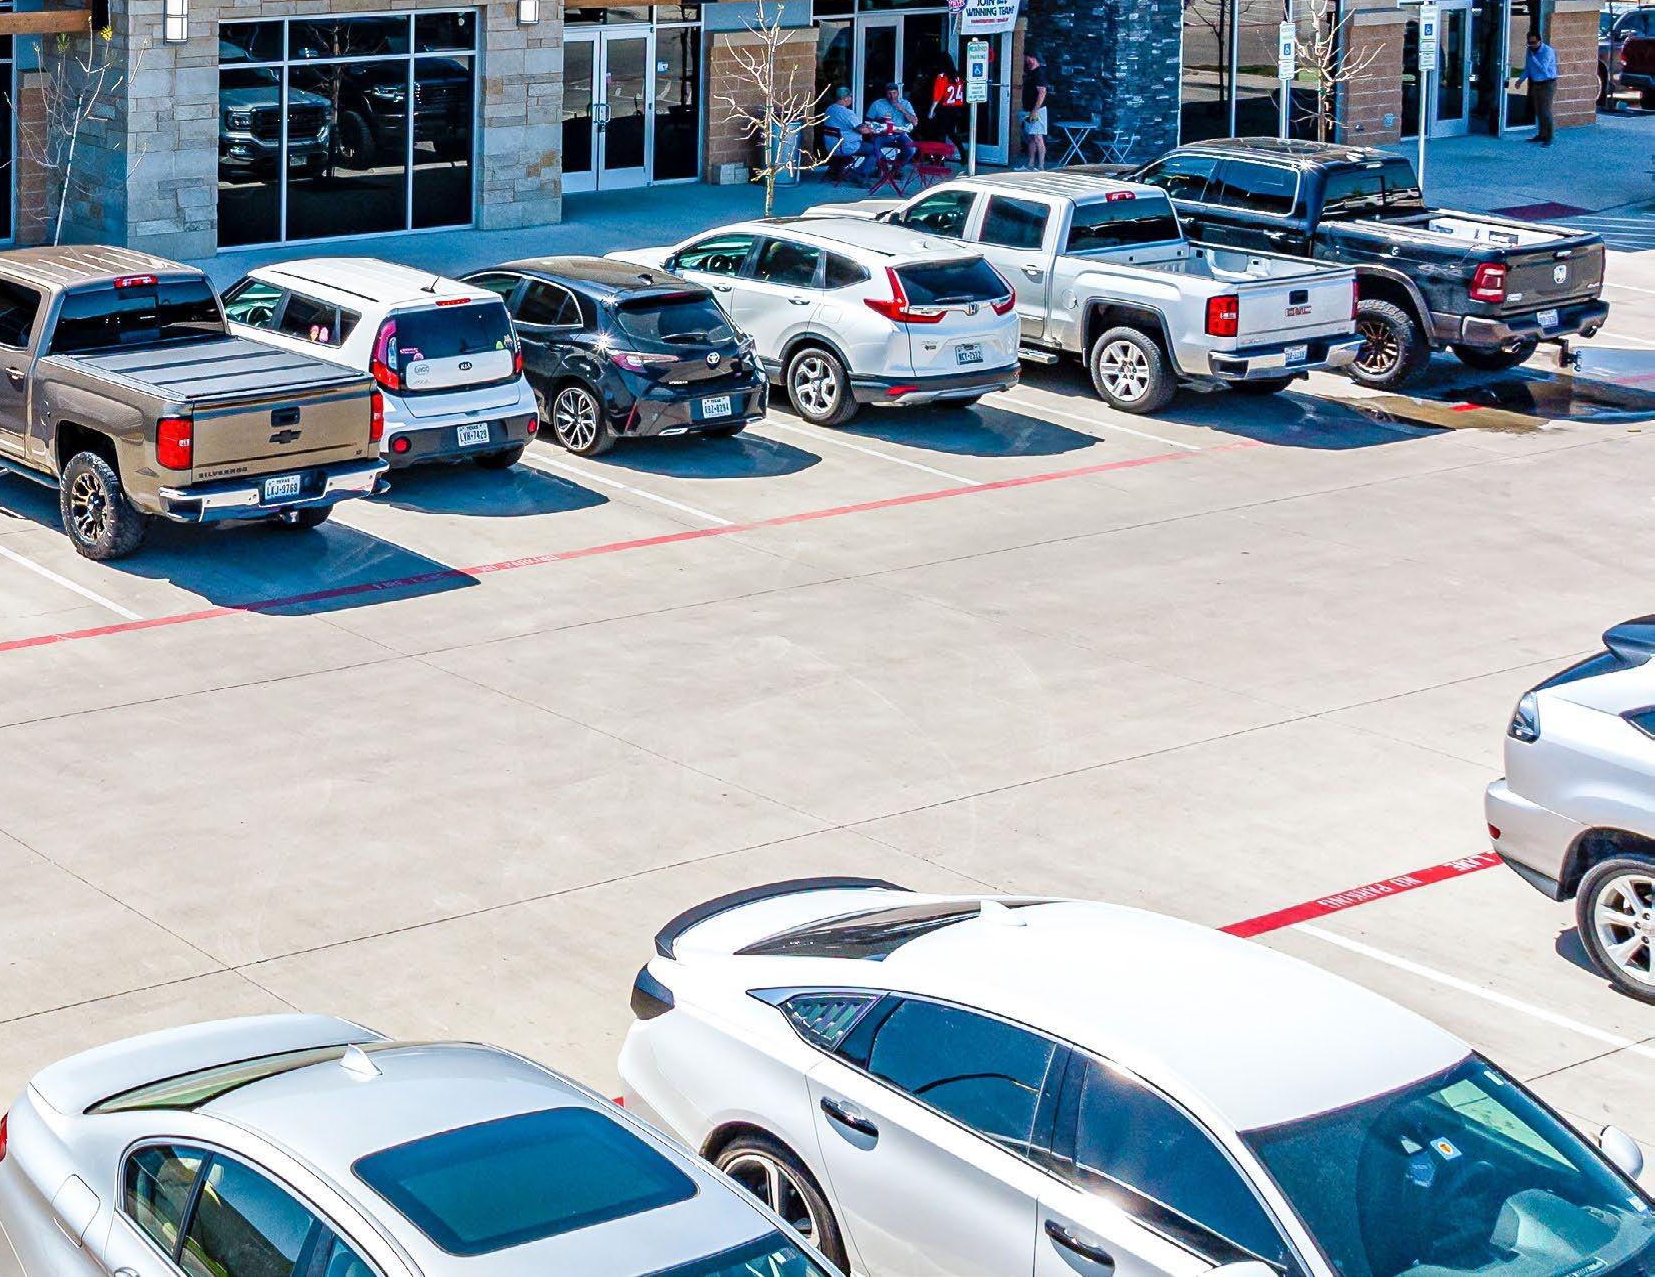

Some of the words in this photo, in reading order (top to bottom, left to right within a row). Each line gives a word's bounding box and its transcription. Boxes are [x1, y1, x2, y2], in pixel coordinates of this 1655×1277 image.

[966, 7, 997, 17] WINNING
[947, 84, 963, 103] 24
[460, 363, 473, 371] KIA
[1317, 882, 1393, 909] PARKING
